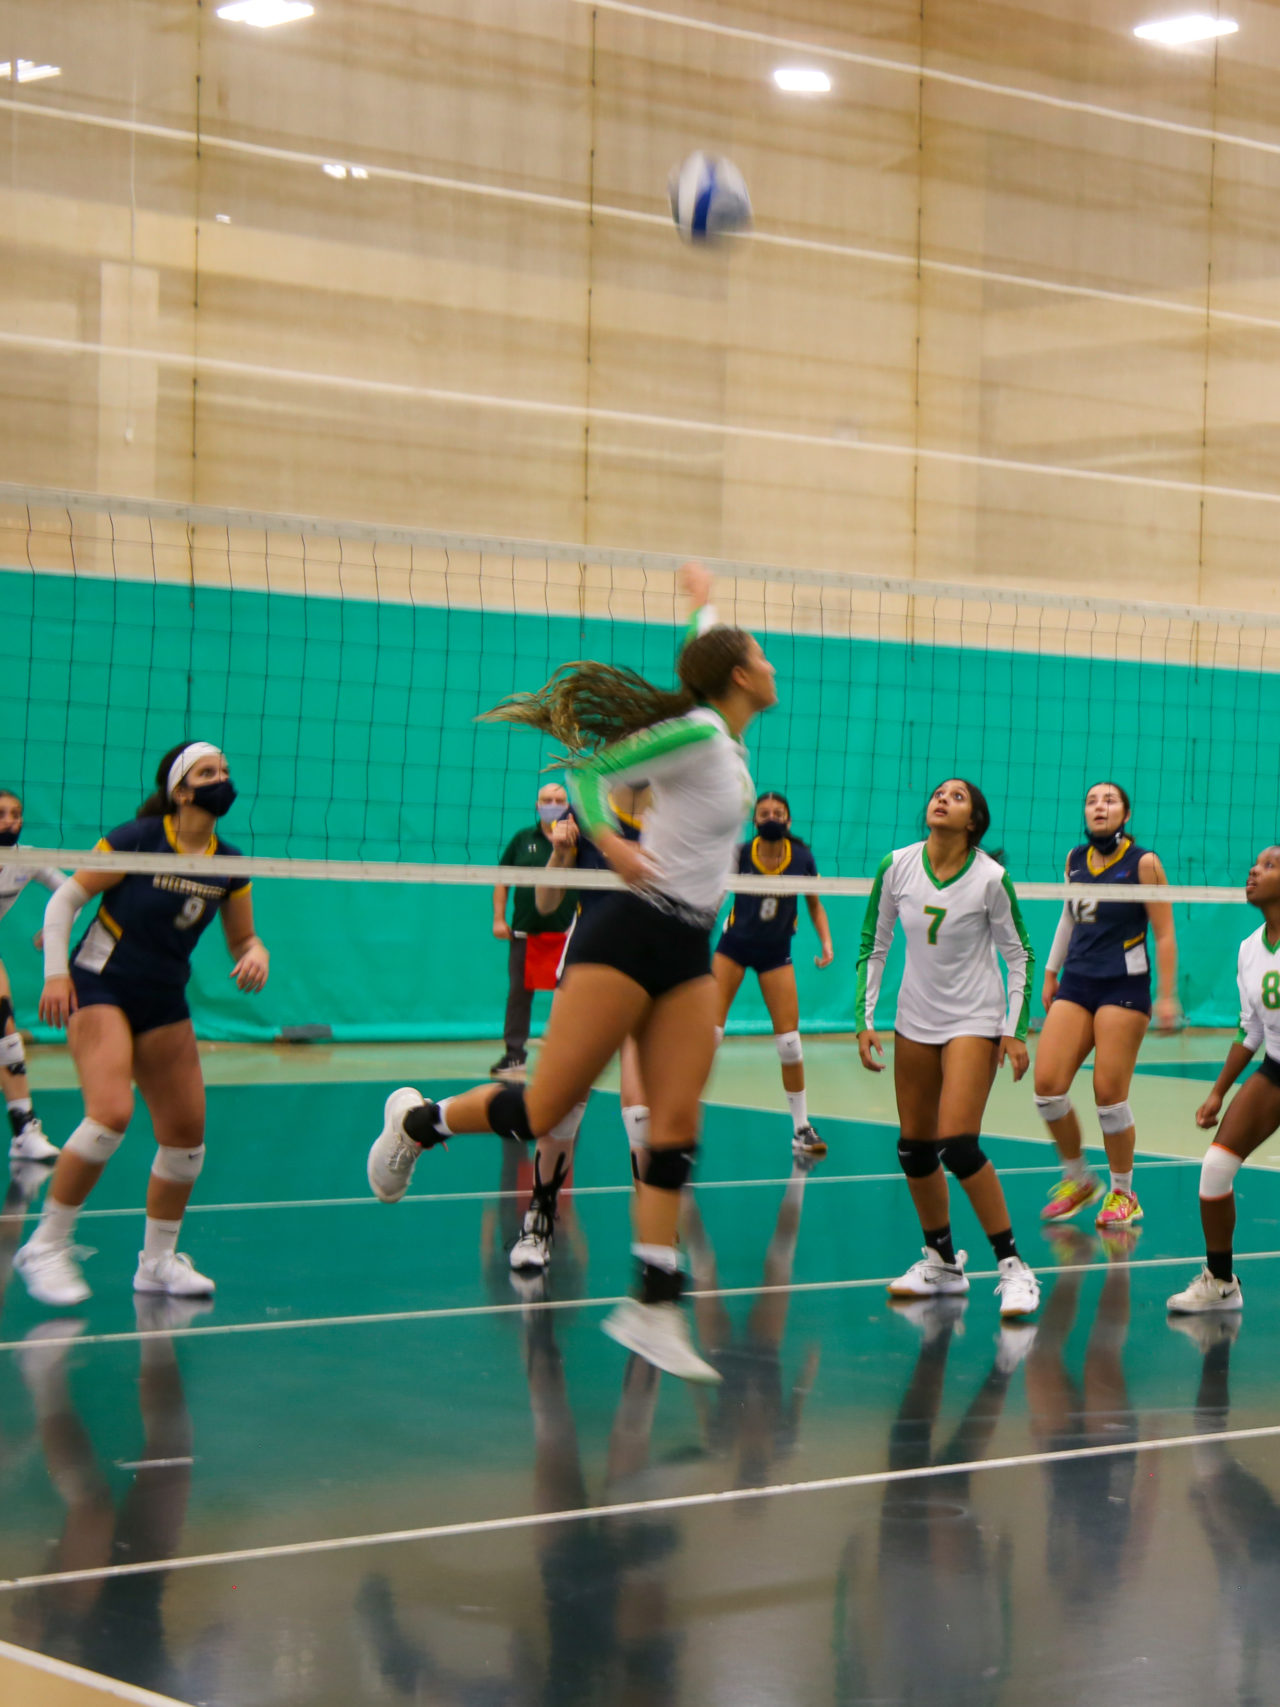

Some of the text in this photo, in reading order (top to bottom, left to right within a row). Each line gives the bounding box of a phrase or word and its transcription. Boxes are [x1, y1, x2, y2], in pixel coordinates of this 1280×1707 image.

[175, 896, 206, 929] 9
[760, 898, 778, 921] 8
[924, 905, 947, 945] 7
[1071, 898, 1097, 922] 12
[1262, 970, 1280, 1010] 8
